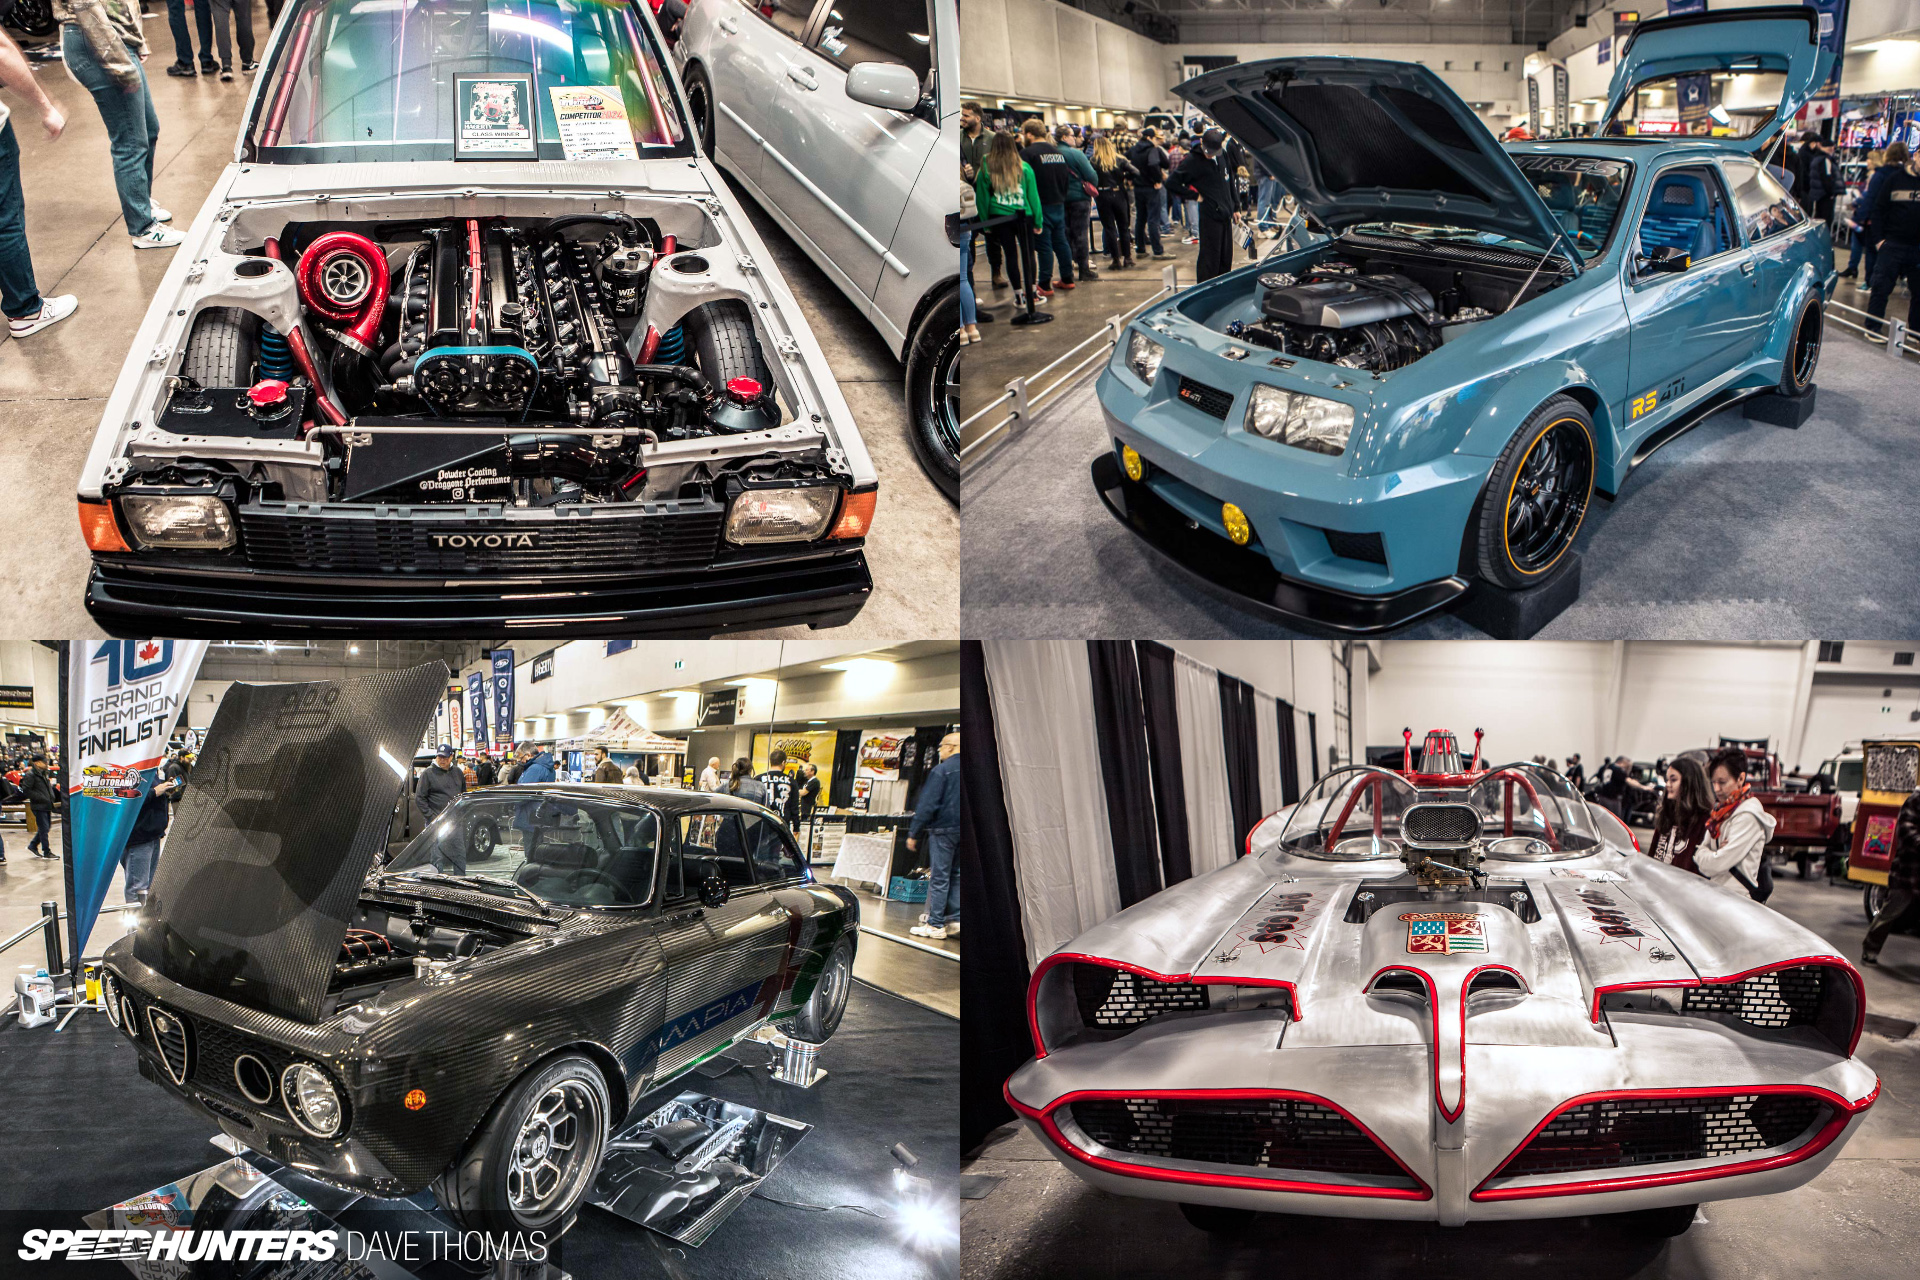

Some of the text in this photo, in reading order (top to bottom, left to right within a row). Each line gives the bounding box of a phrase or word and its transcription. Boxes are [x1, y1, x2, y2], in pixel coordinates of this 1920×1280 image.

[560, 112, 601, 120] COMPETITOR
[618, 287, 636, 297] WIX
[1632, 389, 1657, 419] RS
[437, 466, 498, 482] Powder Coating
[419, 475, 511, 491] @Draggone Performance
[432, 534, 534, 548] TOYOTA
[90, 681, 162, 714] GRAND
[77, 693, 179, 736] CHAMPION
[78, 714, 169, 759] FINALIST
[761, 774, 791, 784] BLOCK
